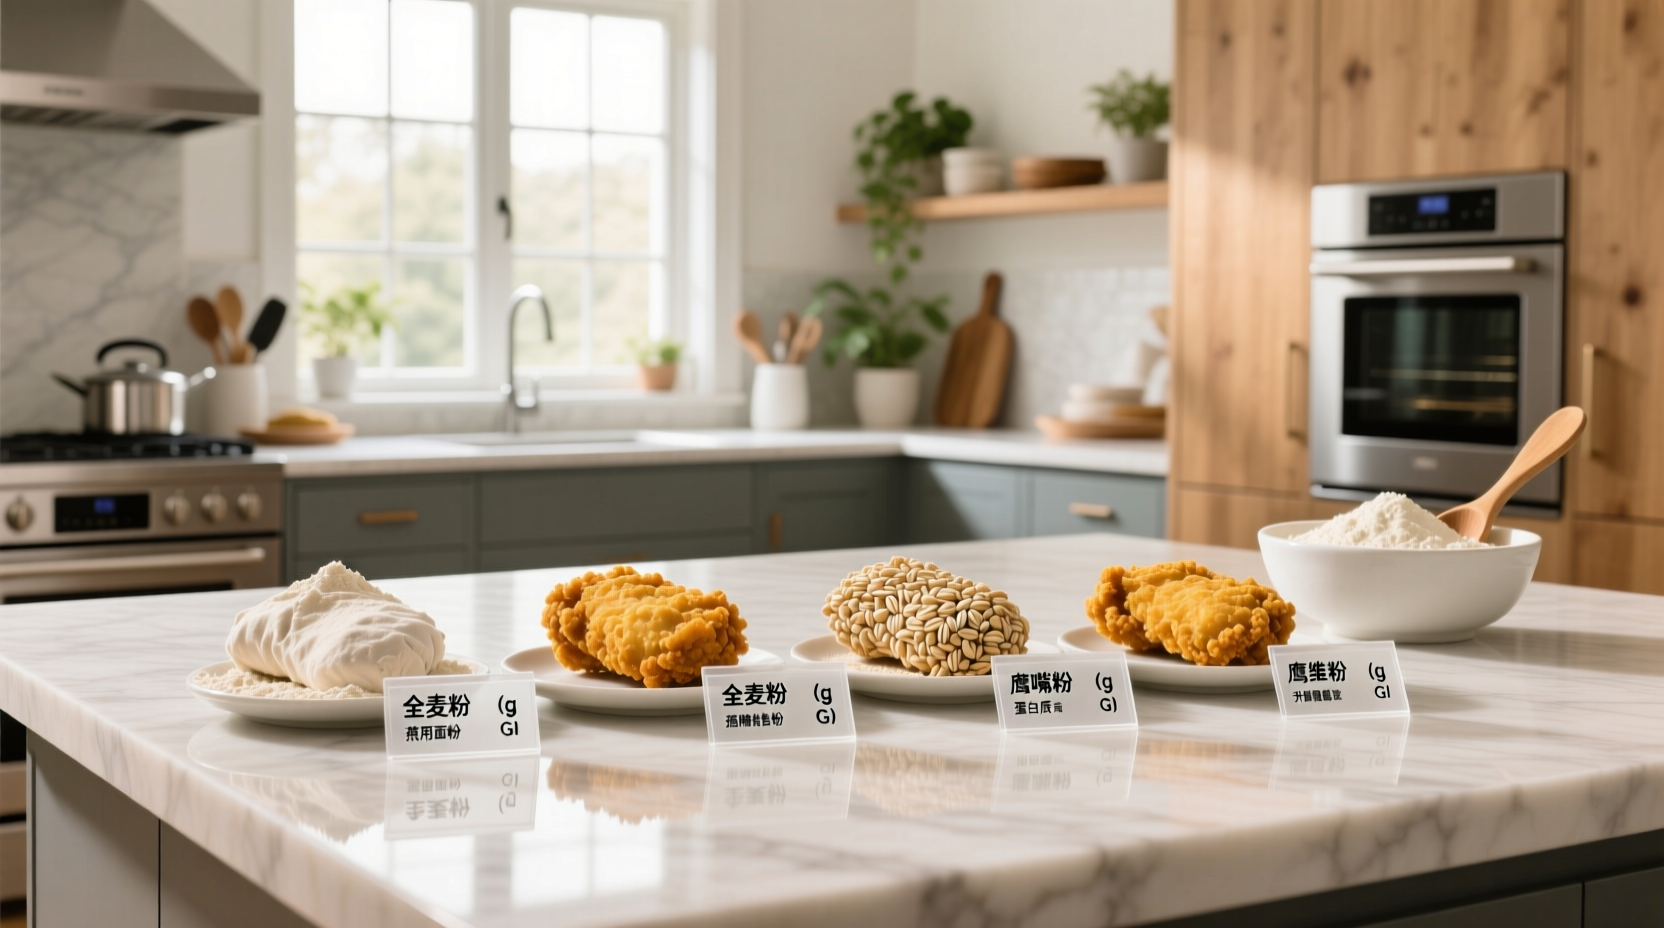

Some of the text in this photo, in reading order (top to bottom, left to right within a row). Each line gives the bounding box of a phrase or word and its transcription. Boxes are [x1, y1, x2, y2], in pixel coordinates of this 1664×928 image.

[1095, 671, 1114, 694] (g
[1368, 662, 1387, 683] (g
[402, 692, 517, 719] 全麦粉 (g
[722, 681, 833, 707] 全麦粉 (g
